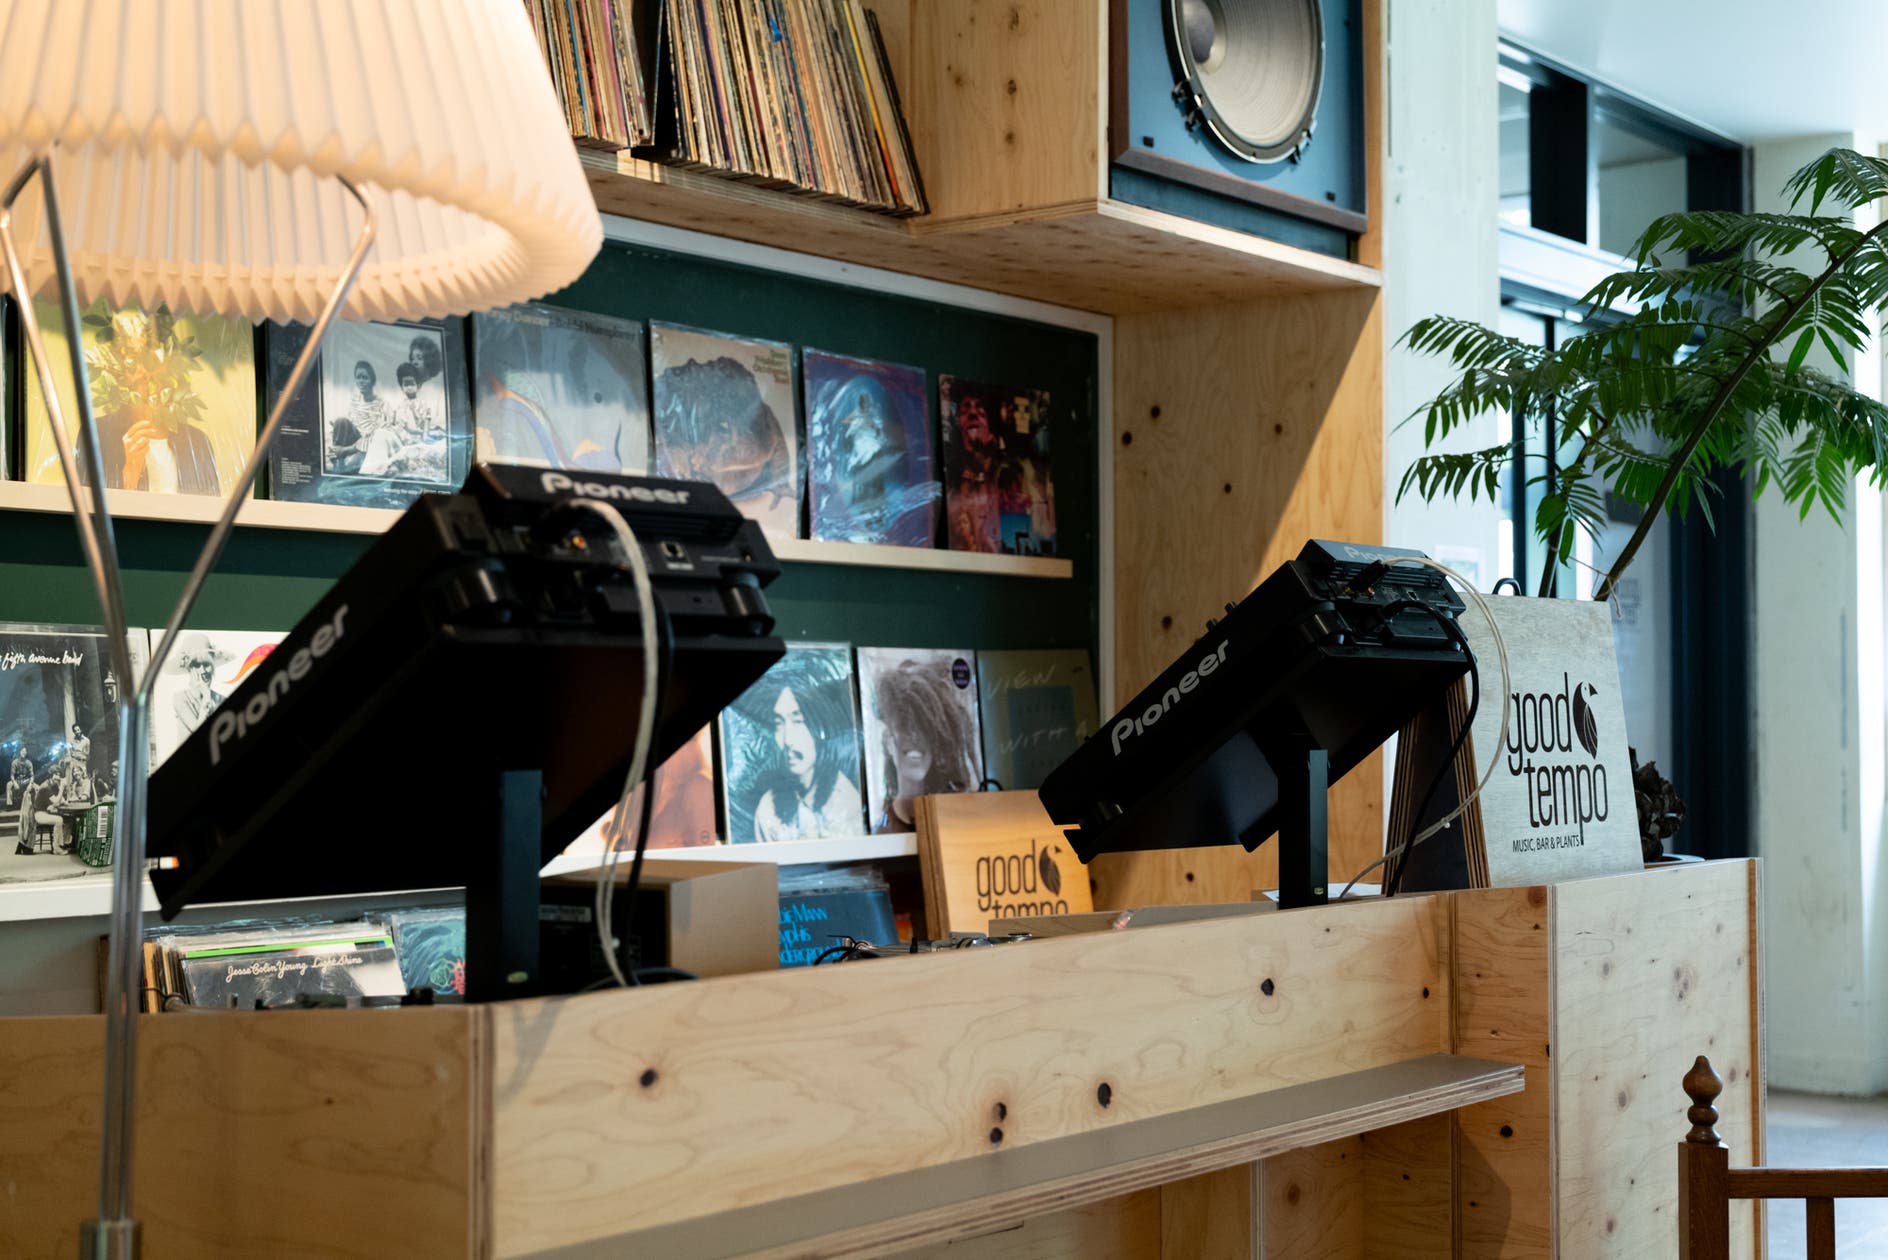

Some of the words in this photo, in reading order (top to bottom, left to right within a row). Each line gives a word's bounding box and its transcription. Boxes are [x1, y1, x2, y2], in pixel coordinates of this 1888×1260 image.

[541, 472, 690, 504] Pioneer
[28, 653, 60, 665] avenue
[210, 604, 348, 767] Pioneer
[987, 664, 1056, 699] VIEW
[1111, 639, 1229, 756] Pioneer
[1507, 672, 1572, 776] good
[1524, 758, 1609, 846] tempo
[1512, 838, 1536, 853] MUSIC,
[1536, 836, 1551, 850] BAR
[1550, 837, 1556, 849] &
[1556, 834, 1580, 848] PLANTS
[976, 838, 1037, 912] good
[226, 965, 251, 983] Jesse
[250, 963, 278, 976] Colin
[277, 960, 308, 979] Young
[312, 957, 337, 973] Light
[336, 955, 363, 966] Shine
